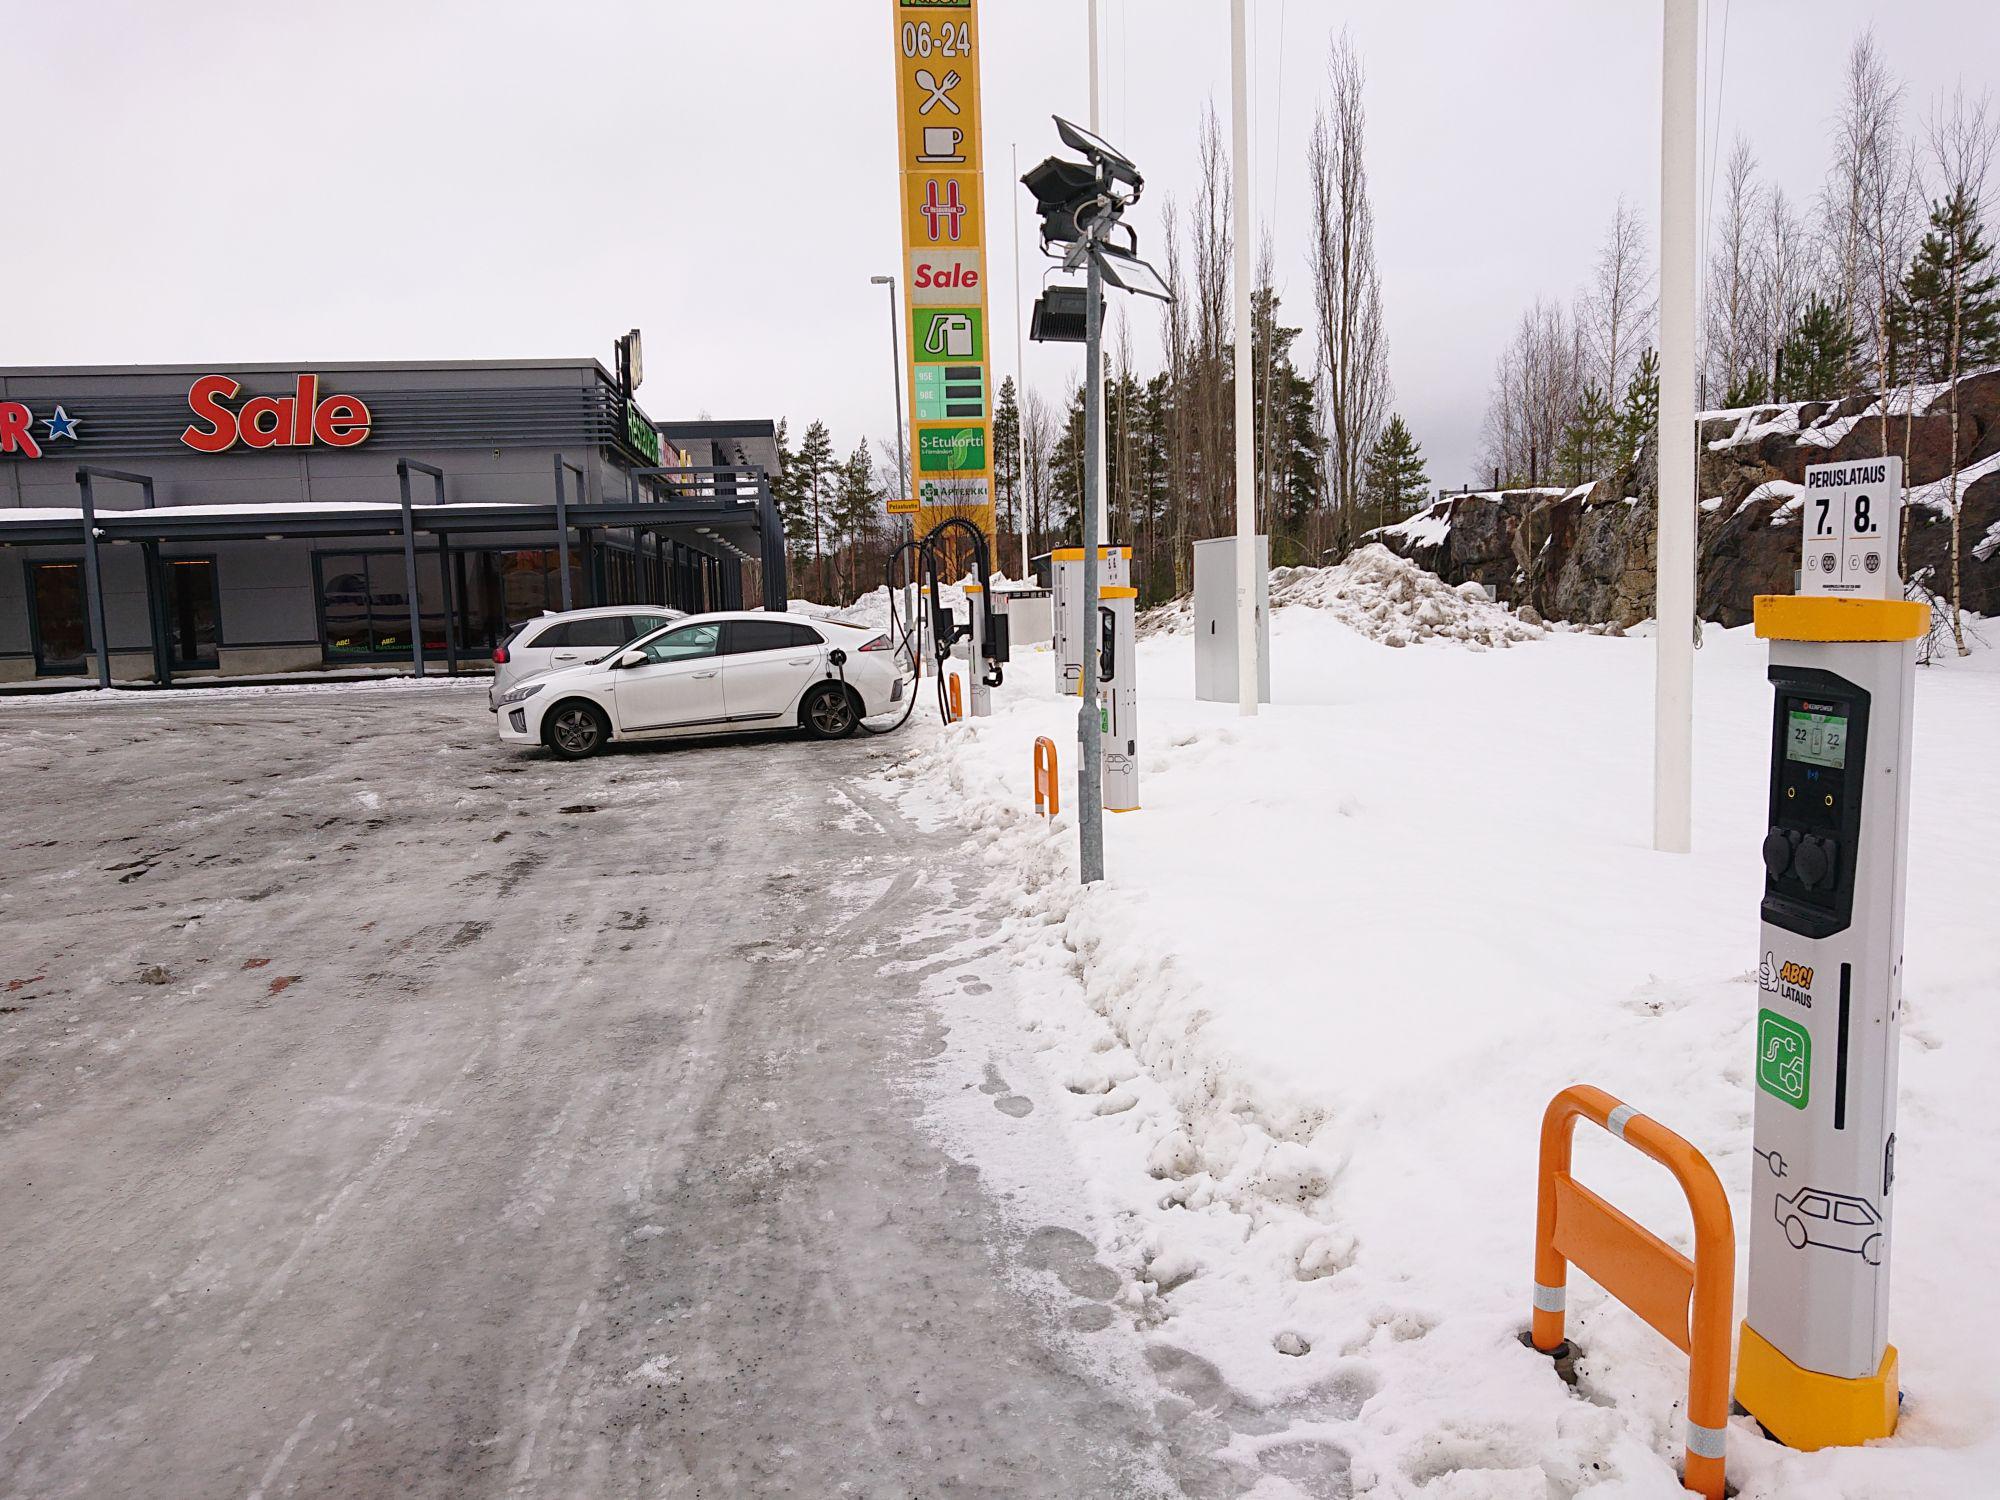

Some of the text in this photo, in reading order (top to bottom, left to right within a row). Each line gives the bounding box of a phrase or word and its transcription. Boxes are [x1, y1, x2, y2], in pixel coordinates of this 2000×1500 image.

[902, 21, 971, 58] 06-24
[914, 263, 979, 288] Sale
[180, 374, 372, 453] Sale
[921, 435, 984, 448] S-Etukortti
[1809, 465, 1885, 488] PERUSLATAUS
[941, 486, 988, 496] APTEEKKI
[1815, 494, 1878, 535] 7. 8.
[1795, 728, 1840, 746] 22 22
[1780, 960, 1814, 990] ABC!
[1781, 984, 1812, 1008] LATAUS
